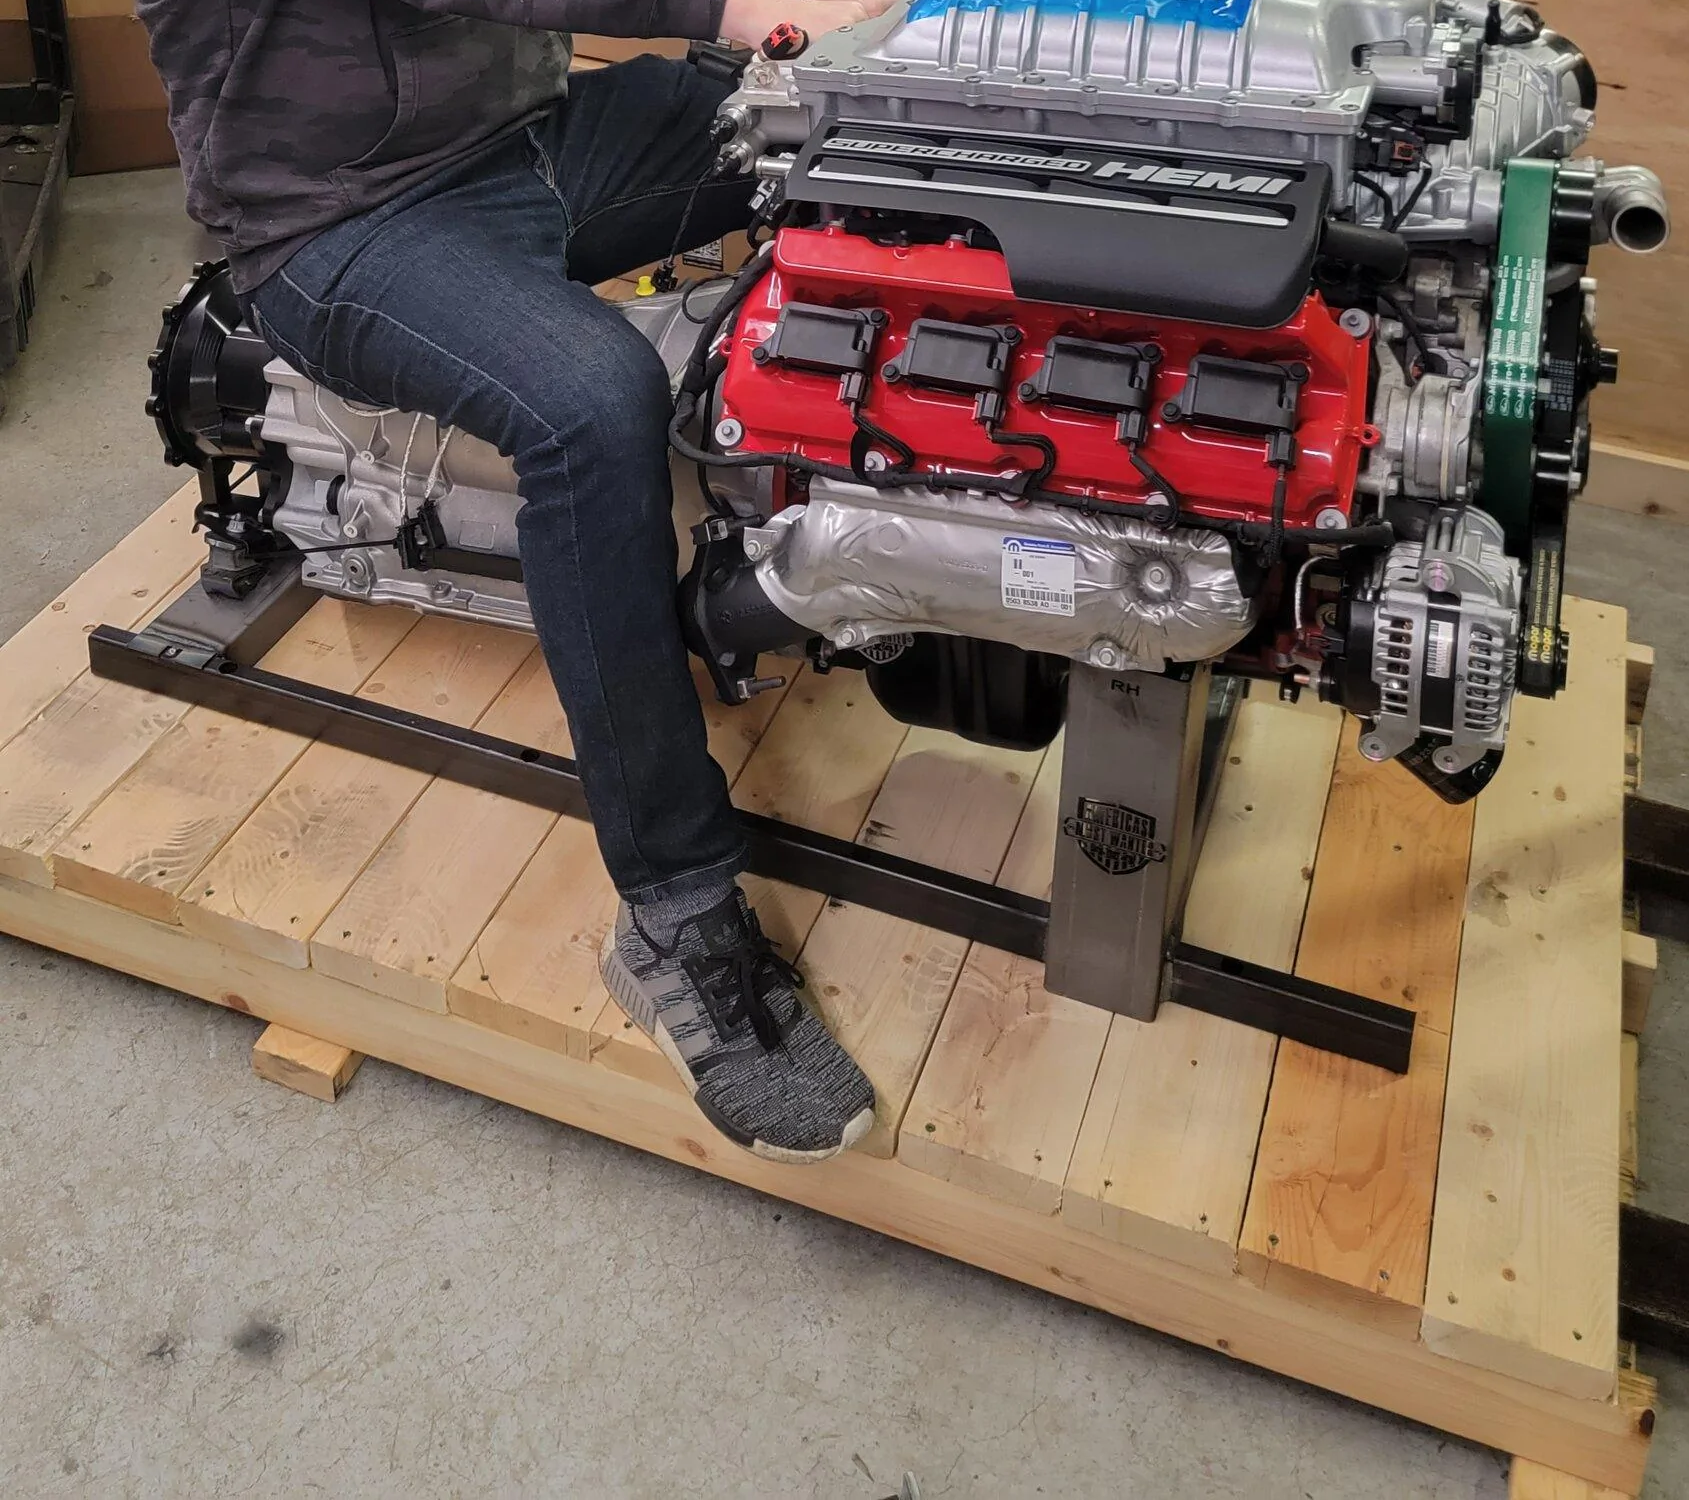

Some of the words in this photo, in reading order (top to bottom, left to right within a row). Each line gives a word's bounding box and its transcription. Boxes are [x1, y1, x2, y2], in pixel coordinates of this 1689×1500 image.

[828, 138, 1089, 171] SUPERCHARGED
[1093, 161, 1292, 195] HEMI
[1111, 679, 1140, 697] RH
